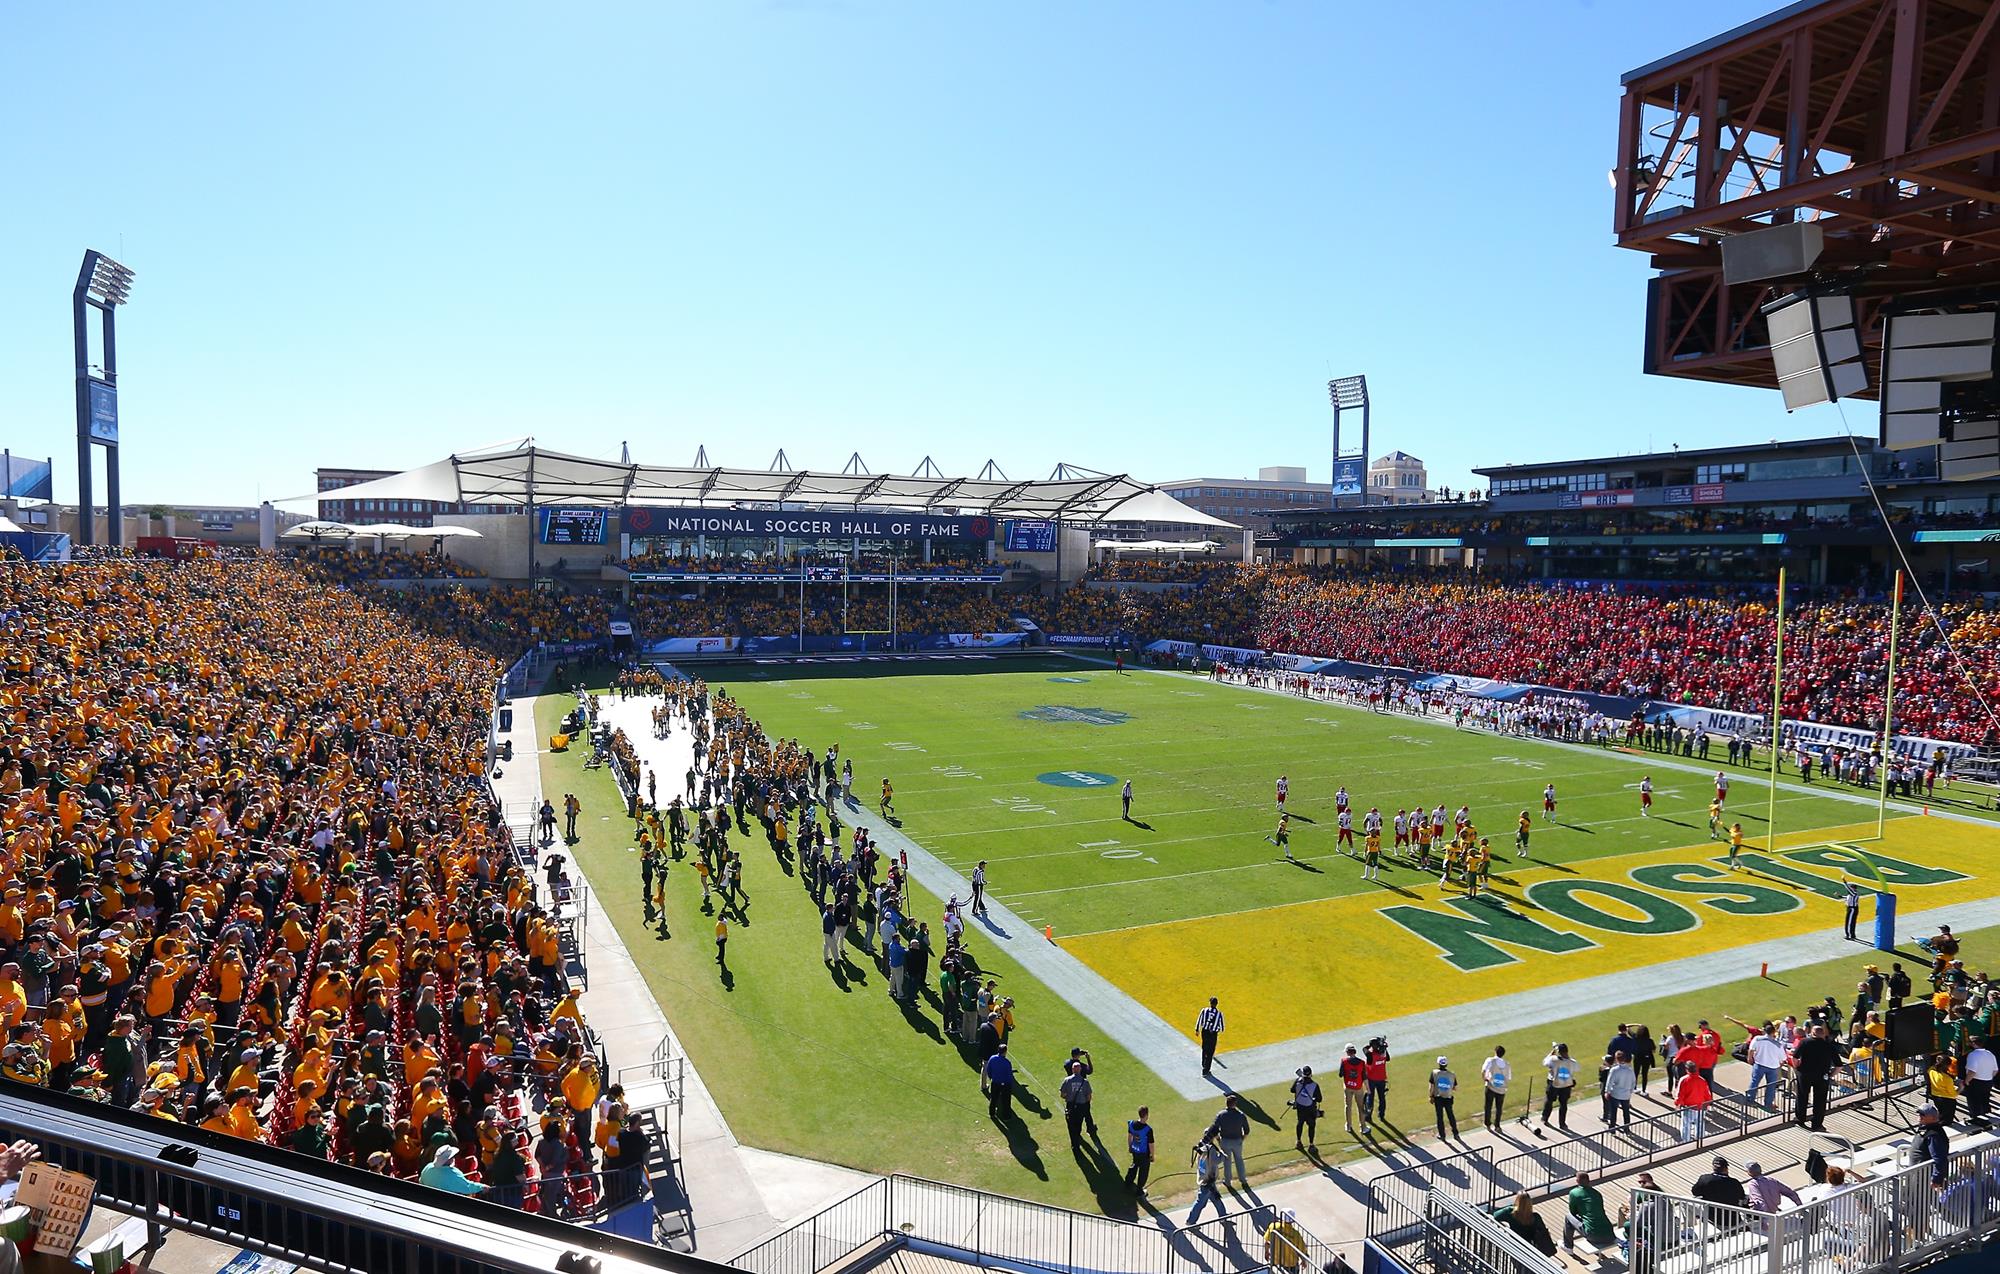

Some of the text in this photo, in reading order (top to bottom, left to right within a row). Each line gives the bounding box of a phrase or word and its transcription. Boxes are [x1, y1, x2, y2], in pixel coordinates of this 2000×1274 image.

[668, 517, 960, 536] NATIONAL SOCCER HALL OF FAME
[1050, 635, 1105, 644] #FCSCHAMPIONSHIP
[1708, 712, 1747, 732] NCAA
[1838, 732, 1927, 762] FOOBALL
[991, 796, 1047, 812] 20
[1076, 838, 1144, 860] 10
[1375, 844, 1977, 973] BISON
